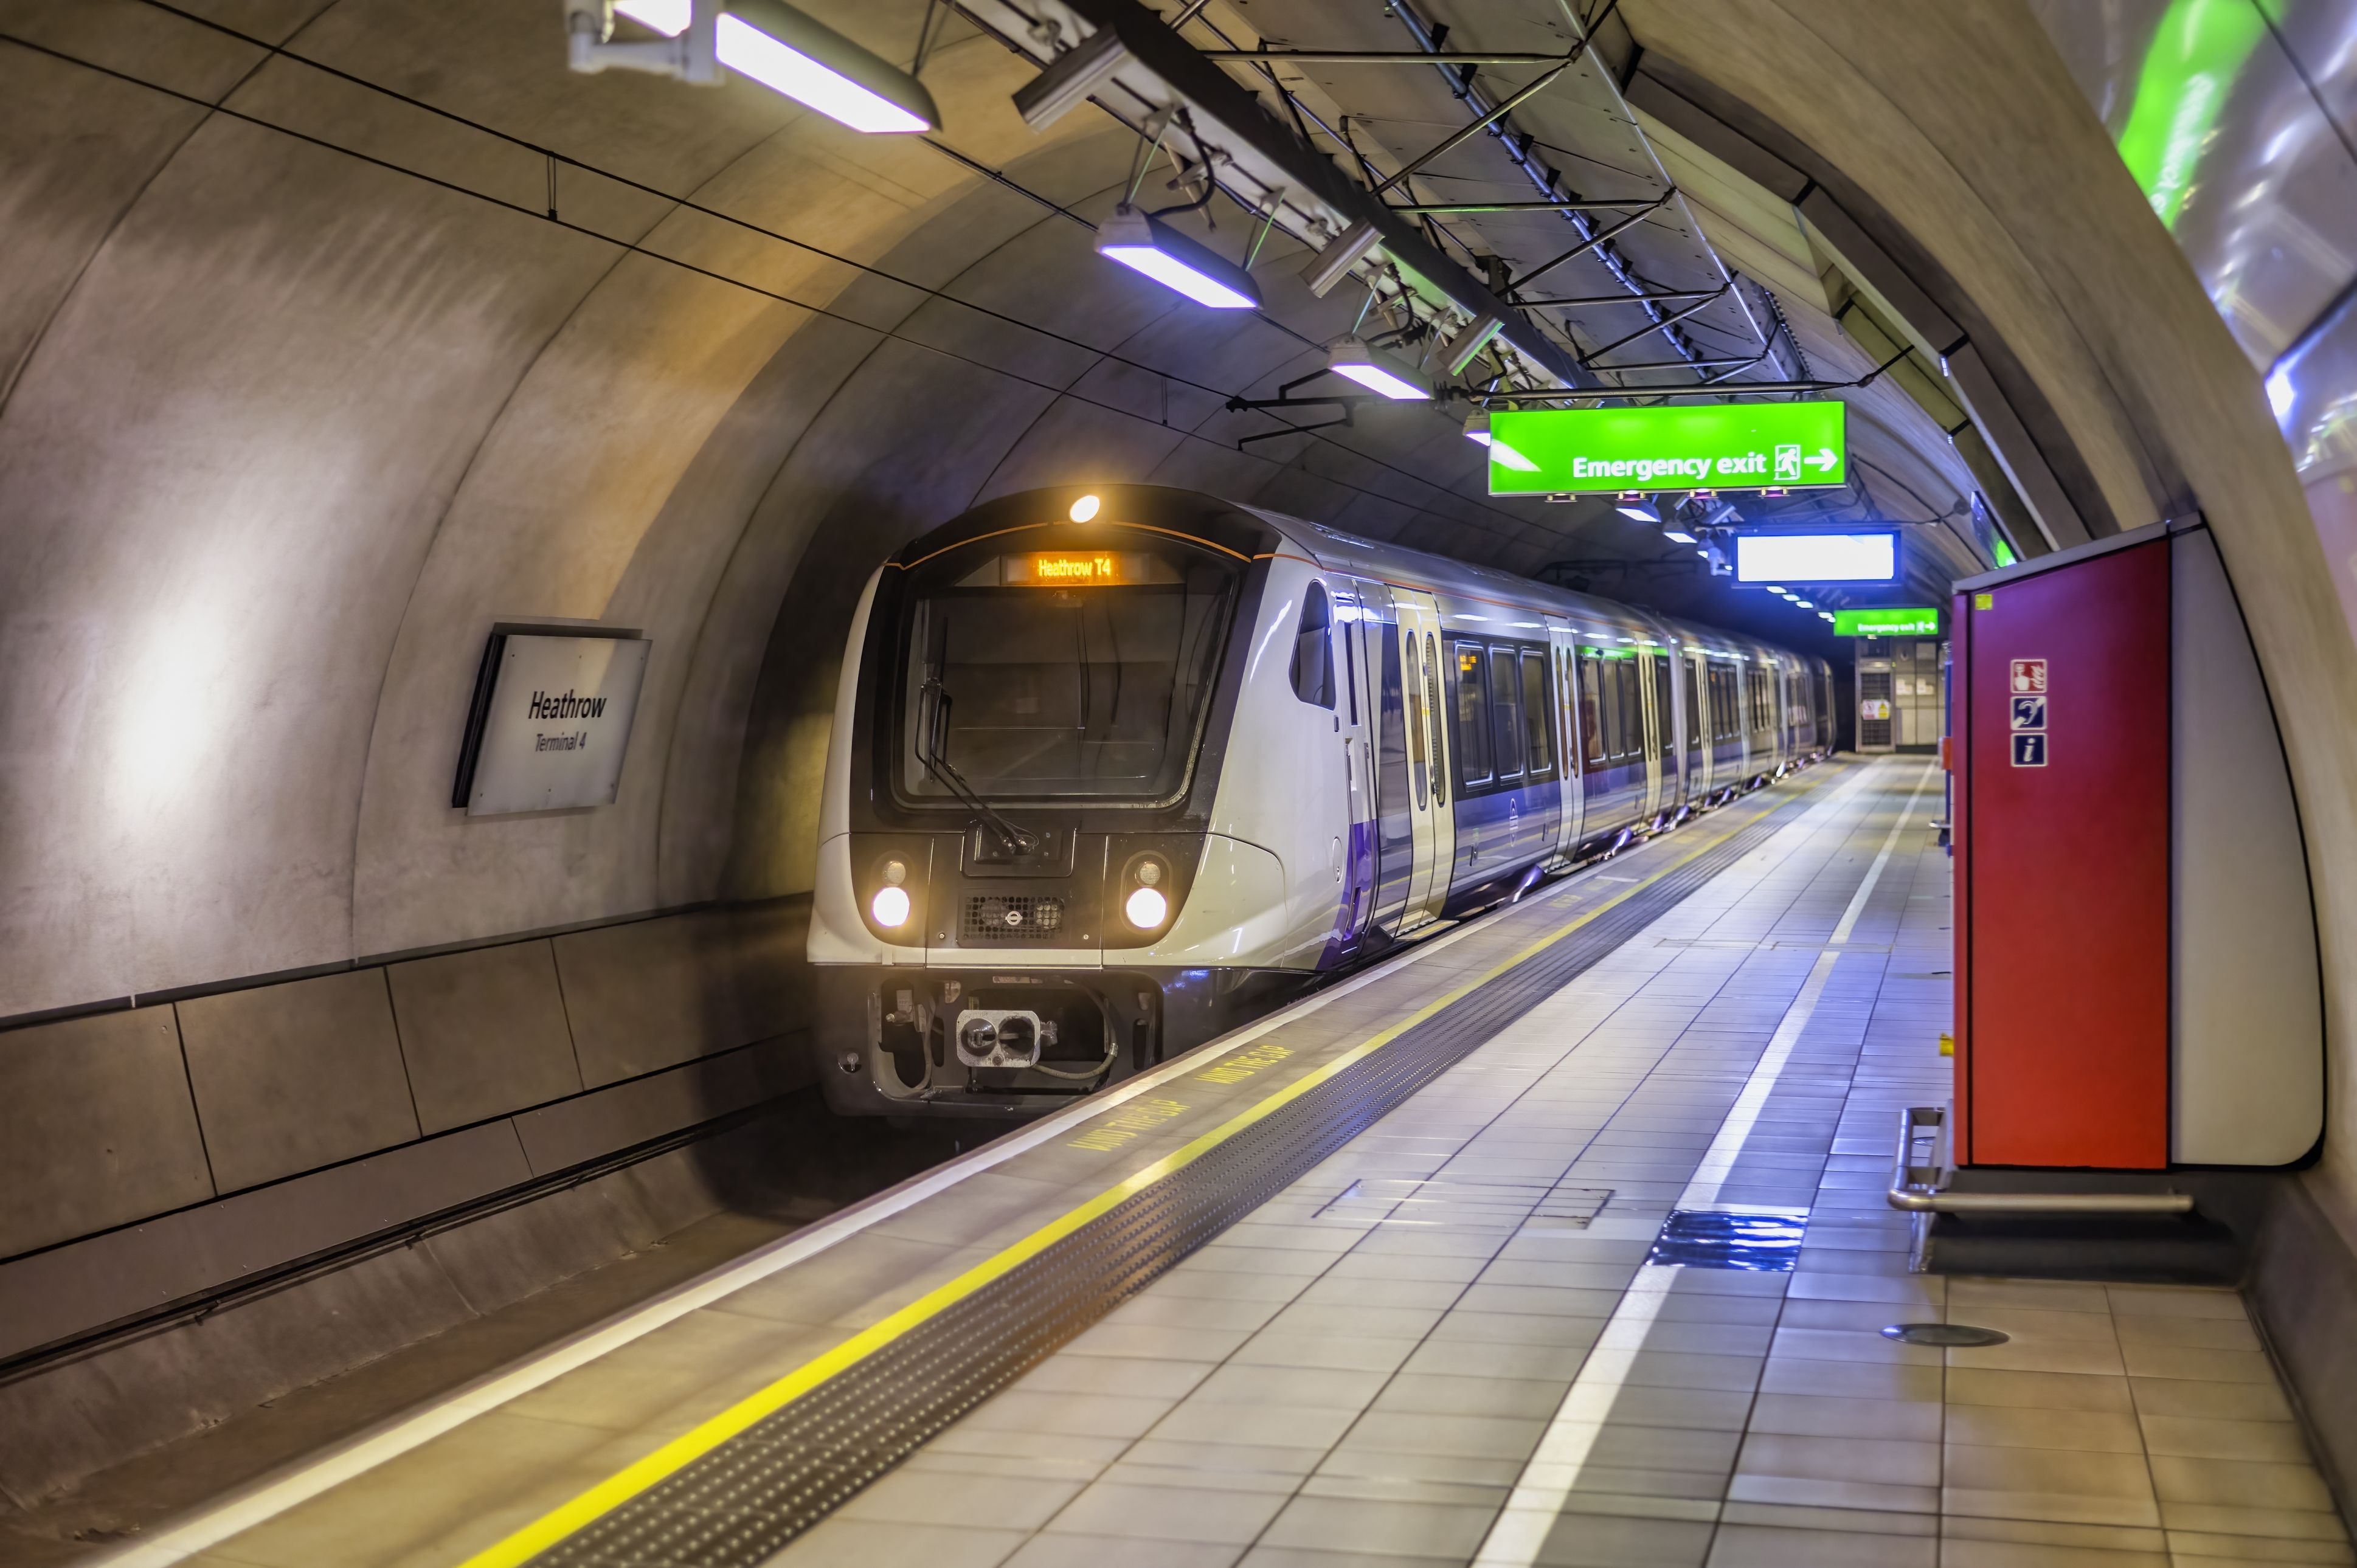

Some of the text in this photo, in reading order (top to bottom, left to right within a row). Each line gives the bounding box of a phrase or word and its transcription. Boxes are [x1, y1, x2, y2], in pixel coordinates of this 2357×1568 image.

[1573, 452, 1767, 481] Emergency exit
[1039, 558, 1110, 576] Heathrow T4
[528, 689, 607, 719] Heathrow
[536, 731, 587, 751] Terminal 4
[1248, 1045, 1296, 1059] GAP
[1223, 1055, 1278, 1069] THE
